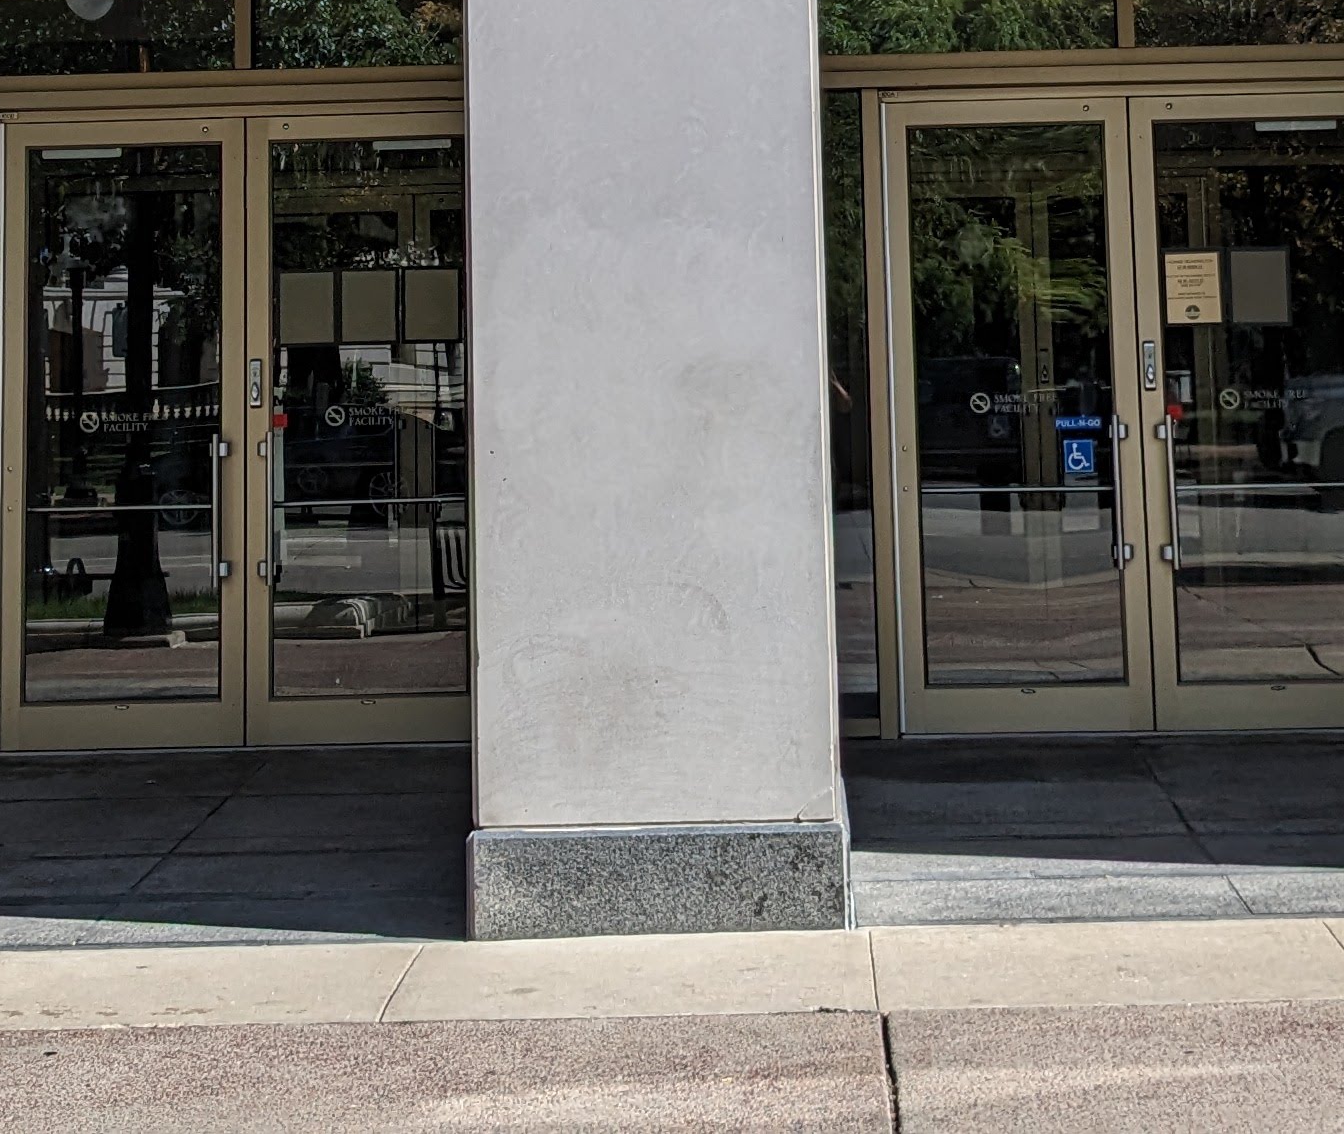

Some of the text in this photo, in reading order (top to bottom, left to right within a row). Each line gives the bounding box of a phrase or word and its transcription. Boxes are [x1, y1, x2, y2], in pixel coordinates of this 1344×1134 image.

[348, 406, 385, 416] SMOKE
[349, 416, 394, 427] FACILITY
[1055, 418, 1102, 429] PULL-N-GO
[103, 422, 149, 433] FACILITY
